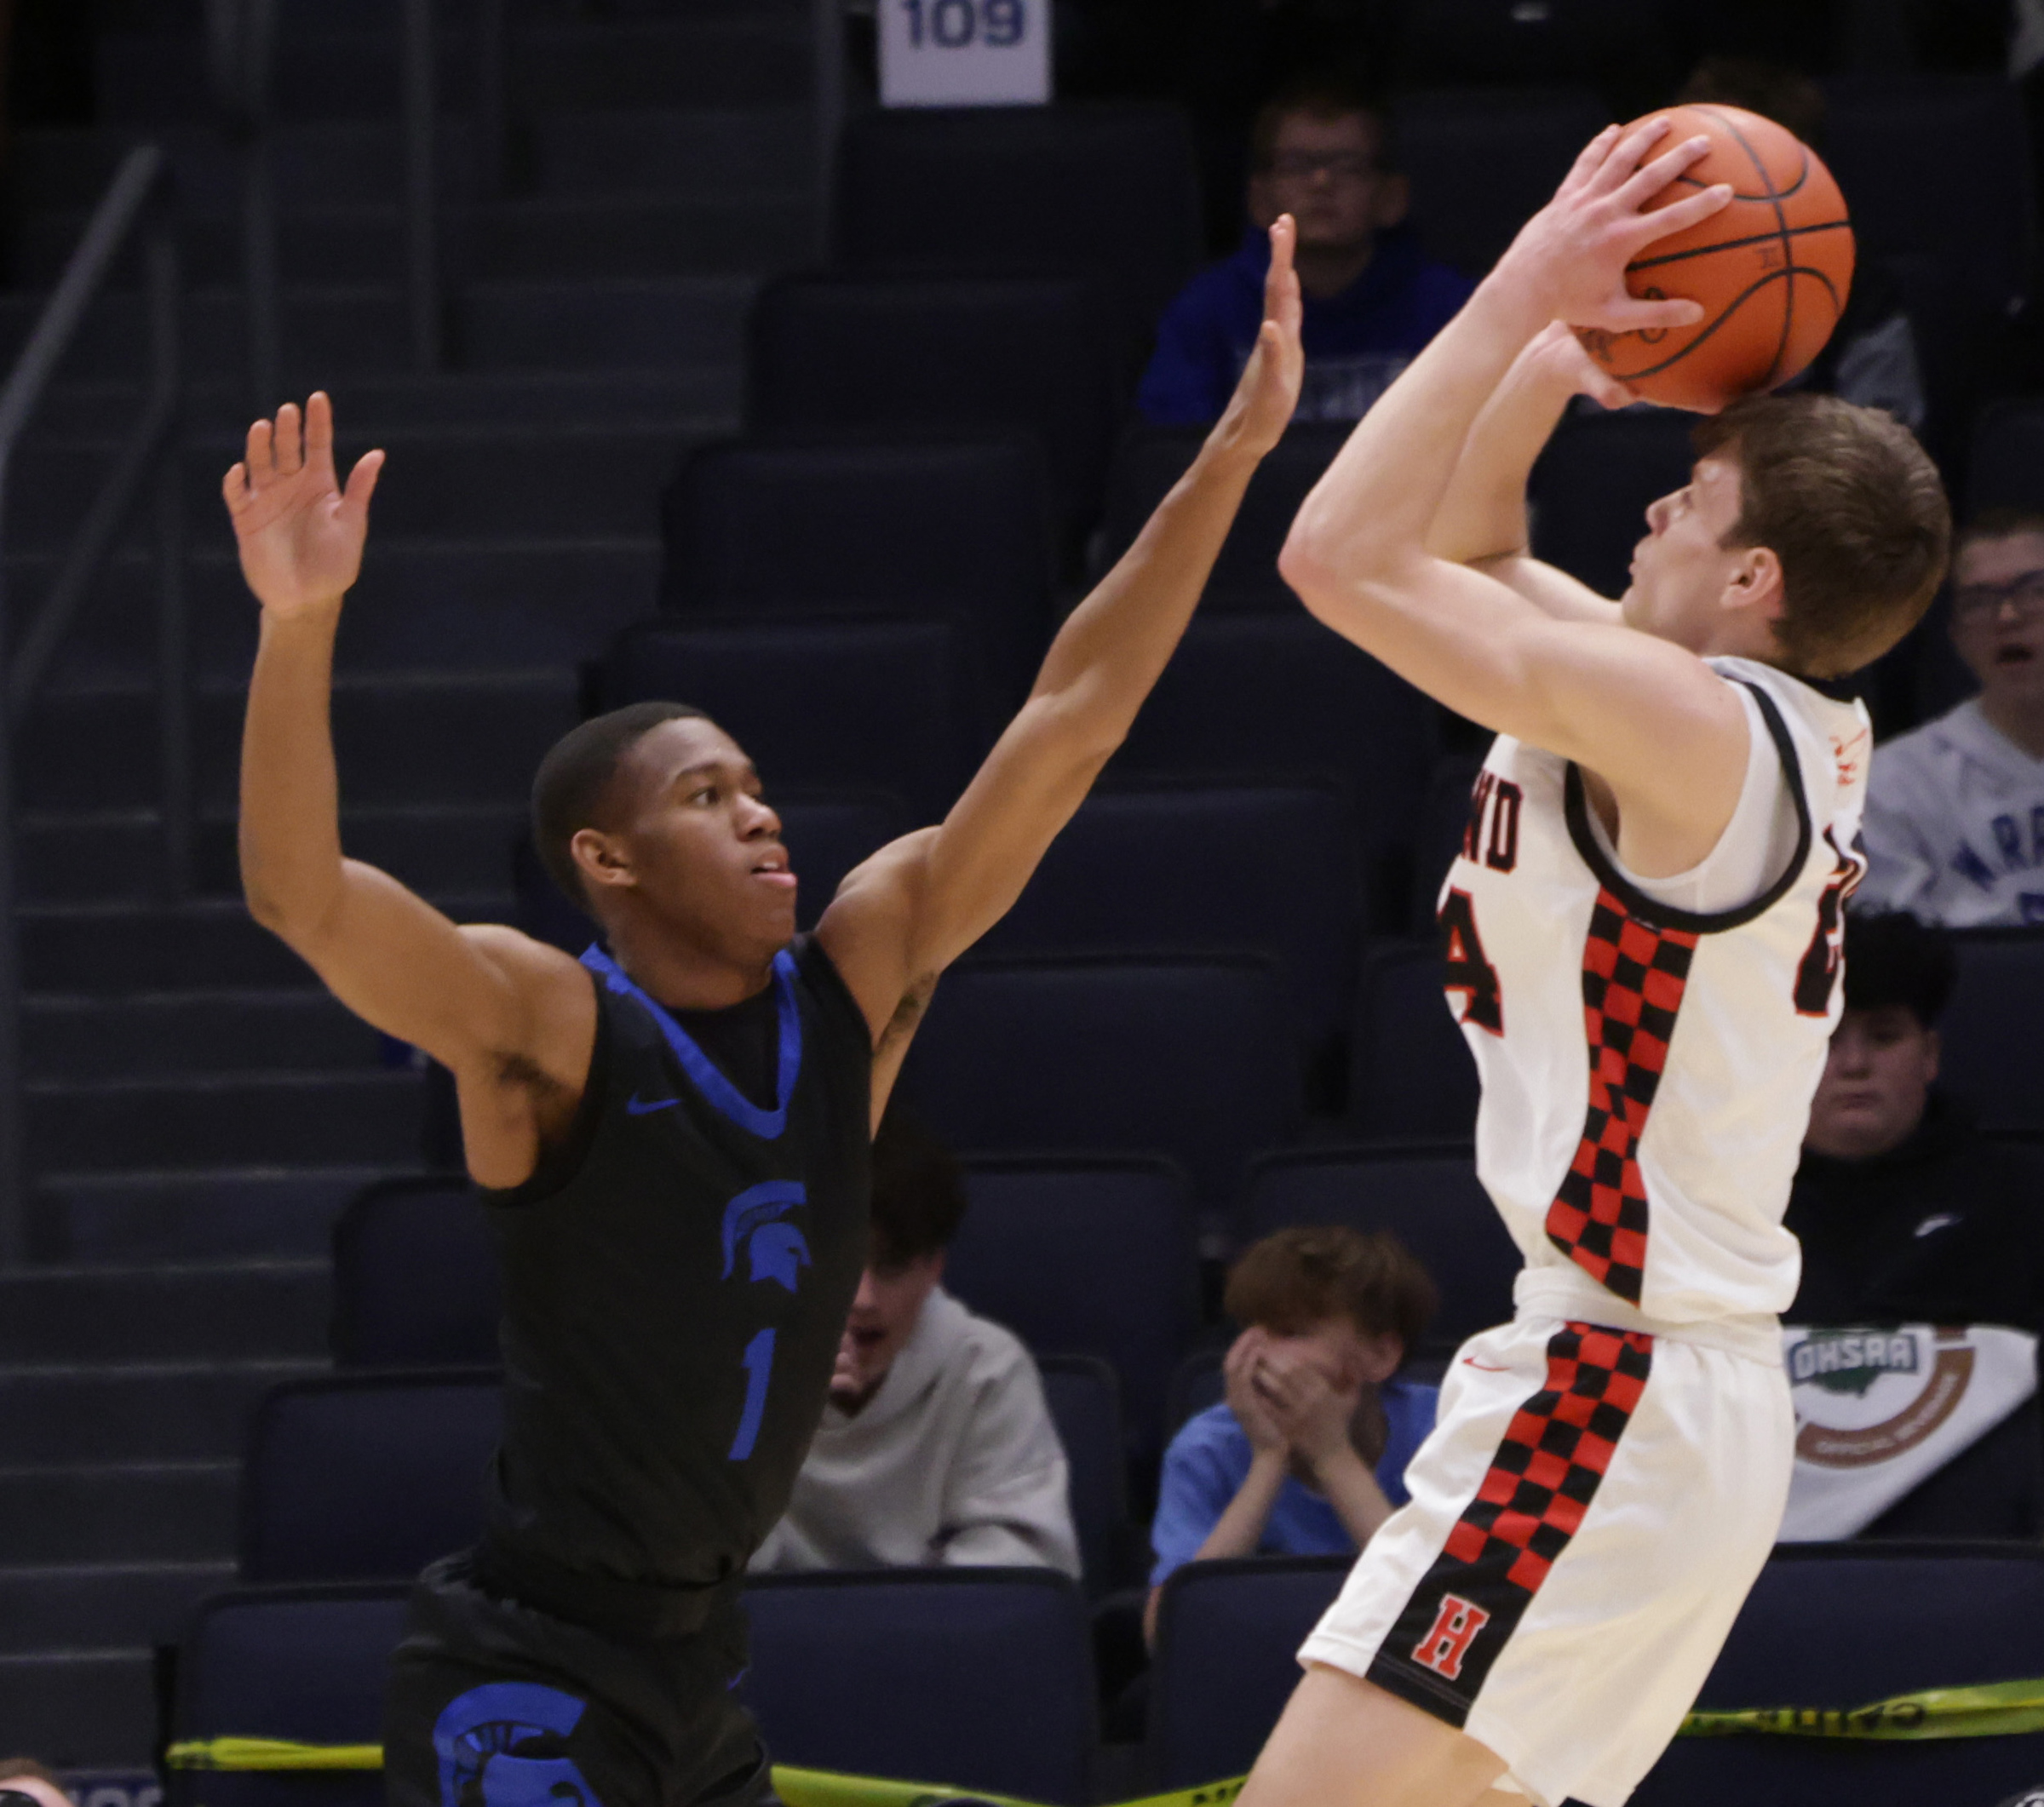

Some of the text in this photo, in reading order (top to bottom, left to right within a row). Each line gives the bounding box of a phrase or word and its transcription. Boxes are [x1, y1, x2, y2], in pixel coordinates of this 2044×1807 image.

[903, 0, 1025, 49] 109
[1793, 1334, 1913, 1381] OHSAA
[727, 1327, 777, 1461] 1
[1410, 1592, 1491, 1682] H
